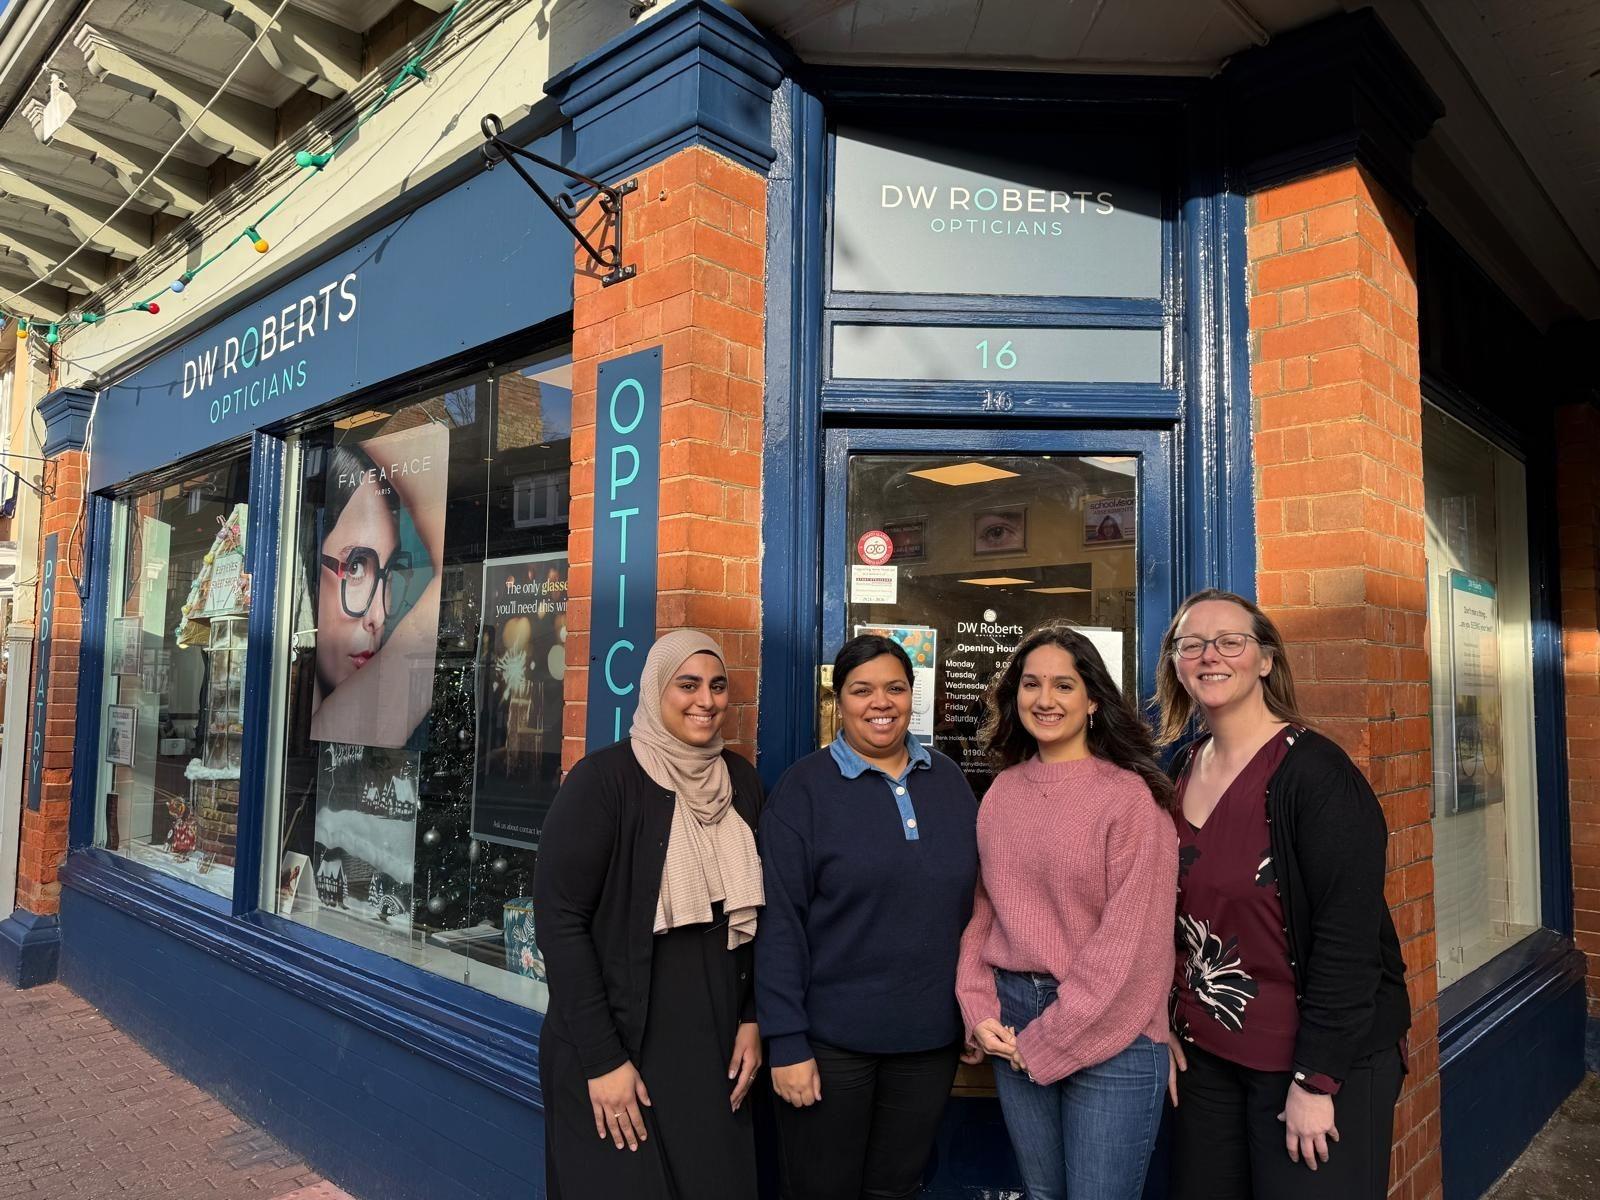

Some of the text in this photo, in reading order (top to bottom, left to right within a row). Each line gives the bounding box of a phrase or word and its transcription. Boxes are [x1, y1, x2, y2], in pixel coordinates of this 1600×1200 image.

[880, 184, 1115, 215] DW ROBERTS
[930, 218, 1063, 236] OPTICIANS
[183, 272, 357, 399] DW ROBERTS
[975, 339, 1018, 369] 16
[209, 359, 307, 424] OPTICIANS
[374, 487, 391, 496] PARIS
[604, 378, 645, 742] OPTICI
[506, 578, 568, 596] The only glasse
[495, 601, 516, 617] you'll
[517, 600, 537, 613] need
[539, 598, 554, 612] this
[957, 622, 1024, 634] DW Roberts
[957, 643, 1018, 654] Opening Hour
[945, 660, 975, 669] Monday
[32, 559, 53, 784] PODIATRY
[945, 671, 977, 680] Tuesday
[945, 681, 989, 691] Wednesday
[945, 692, 980, 701] Thursday
[945, 703, 968, 712] Friday
[945, 713, 978, 724] Saturday
[519, 826, 536, 835] contact
